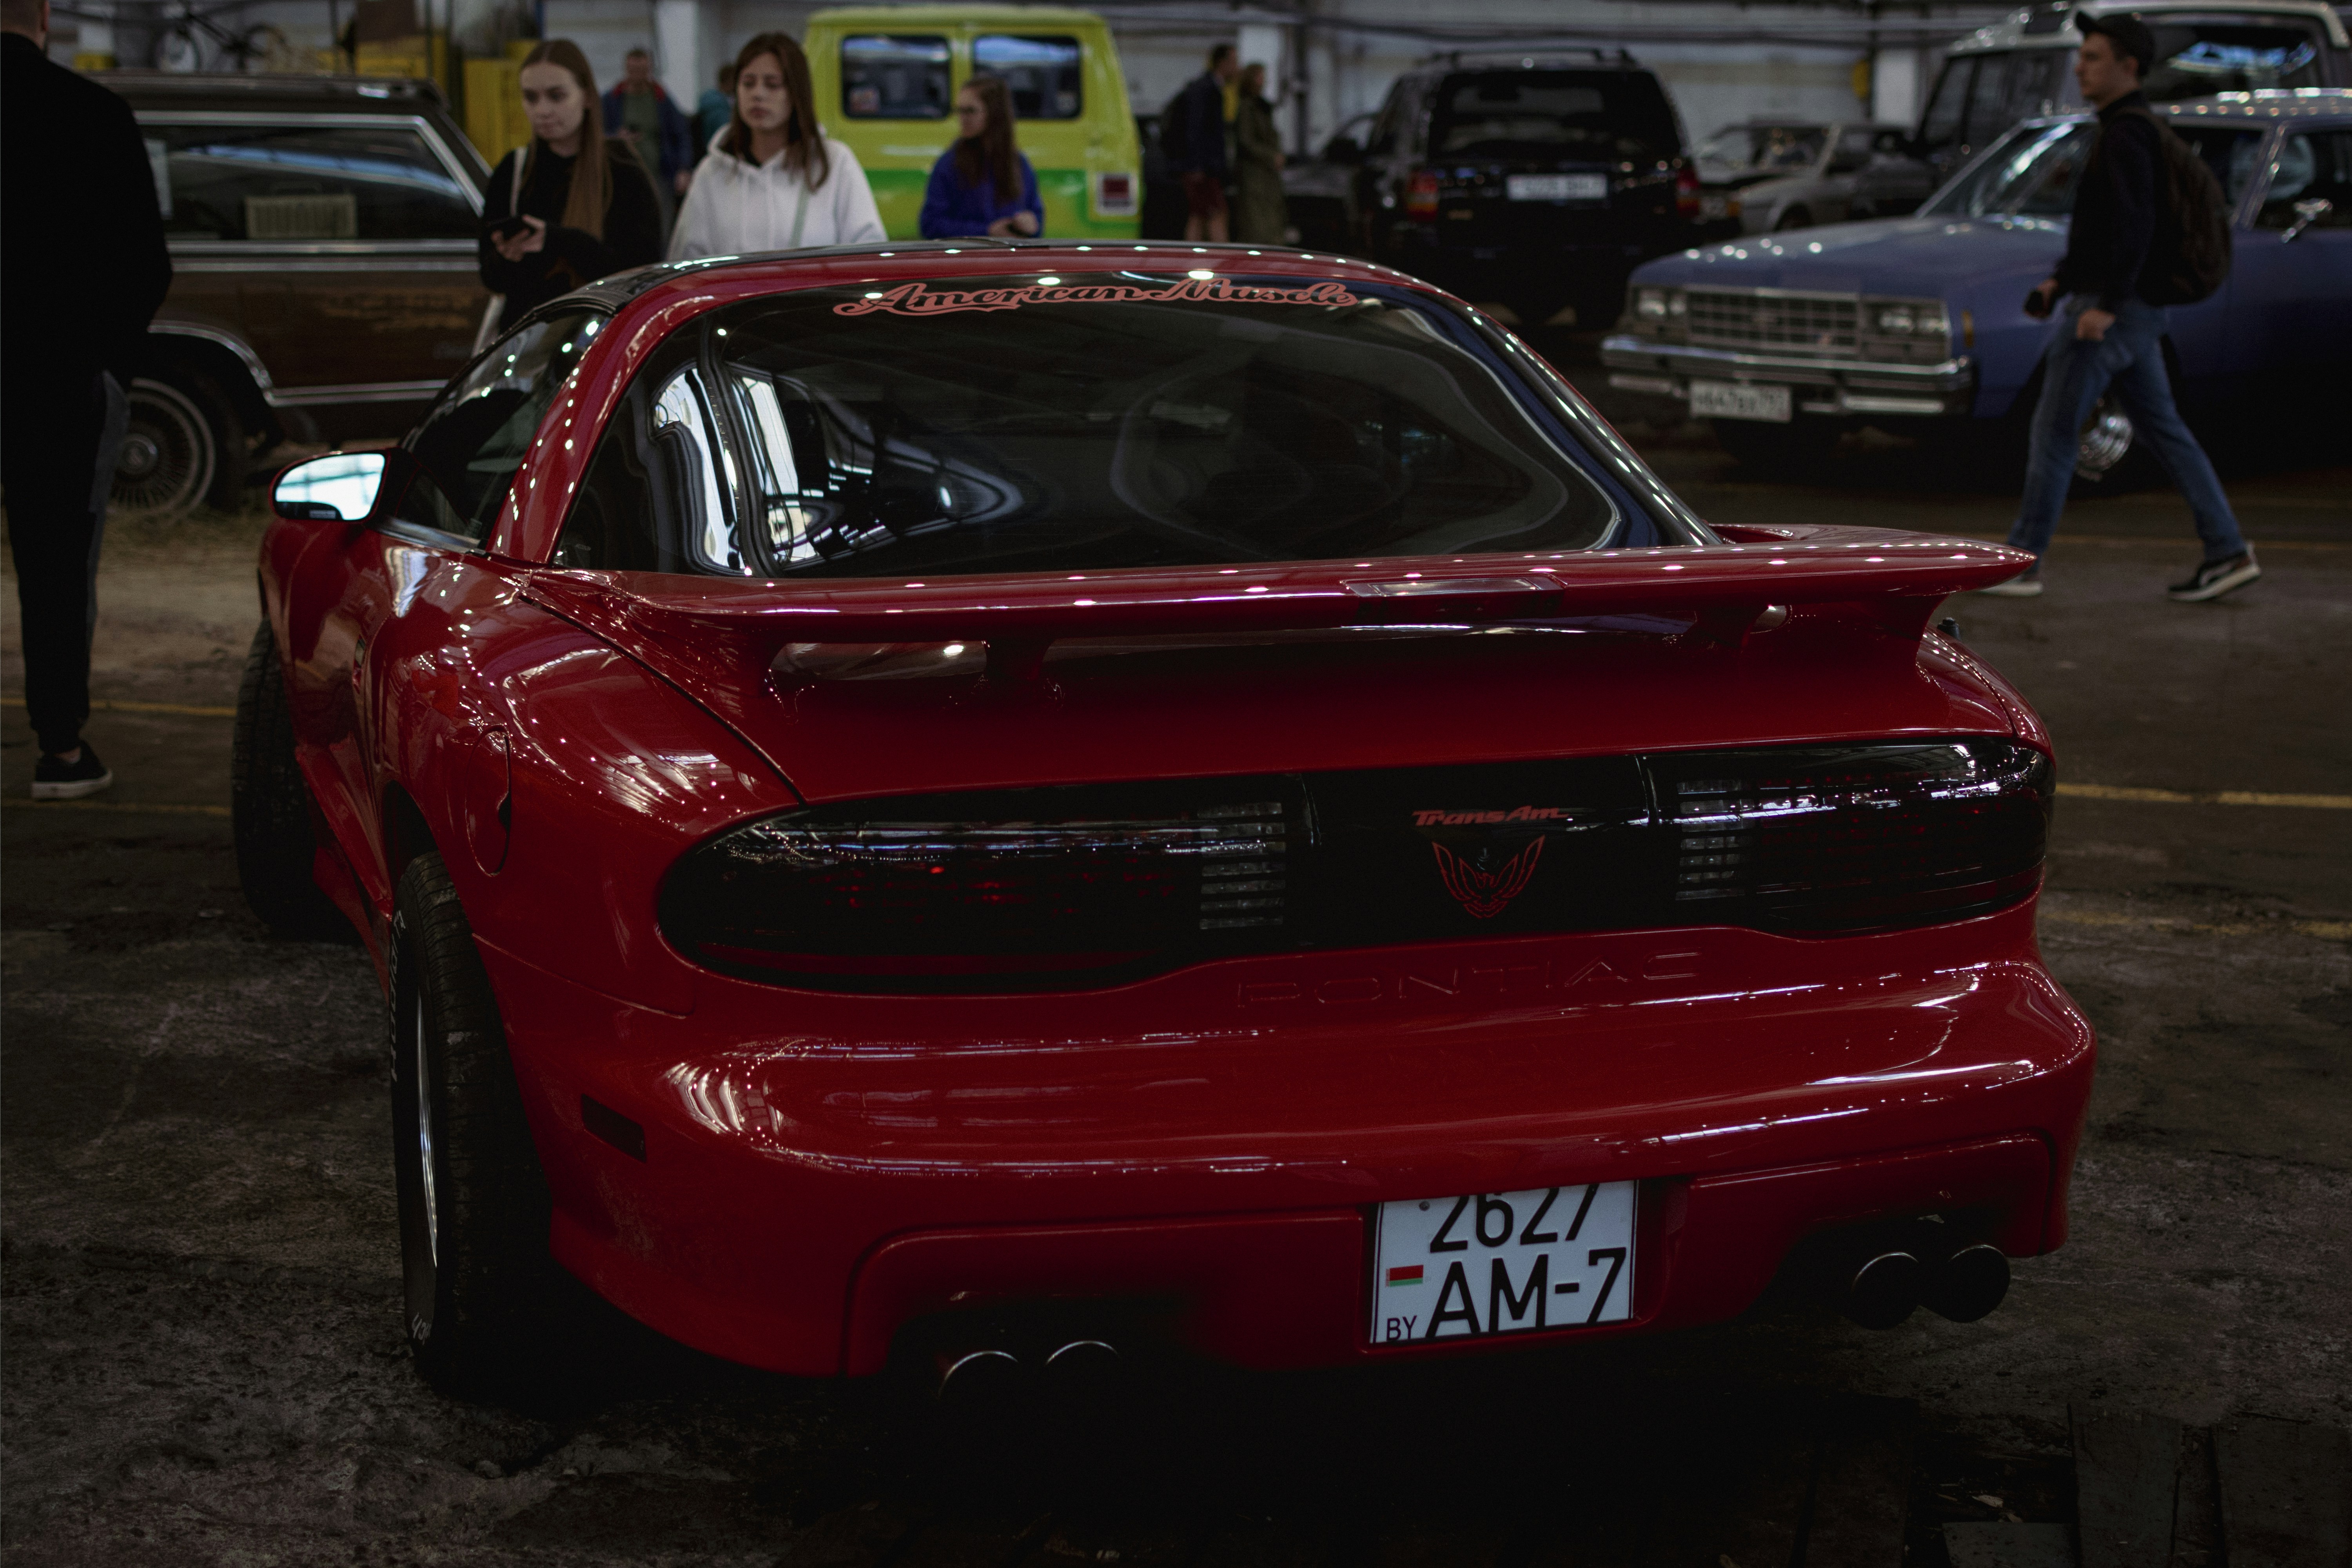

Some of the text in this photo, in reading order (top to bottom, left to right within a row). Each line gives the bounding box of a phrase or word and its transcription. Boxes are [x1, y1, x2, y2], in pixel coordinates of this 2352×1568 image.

[833, 278, 1359, 316] American Muscle
[1237, 947, 1702, 1008] PONTIAC
[1430, 1183, 1599, 1253] 2627
[1425, 1247, 1626, 1338] AM-7
[1387, 1315, 1417, 1341] BY
